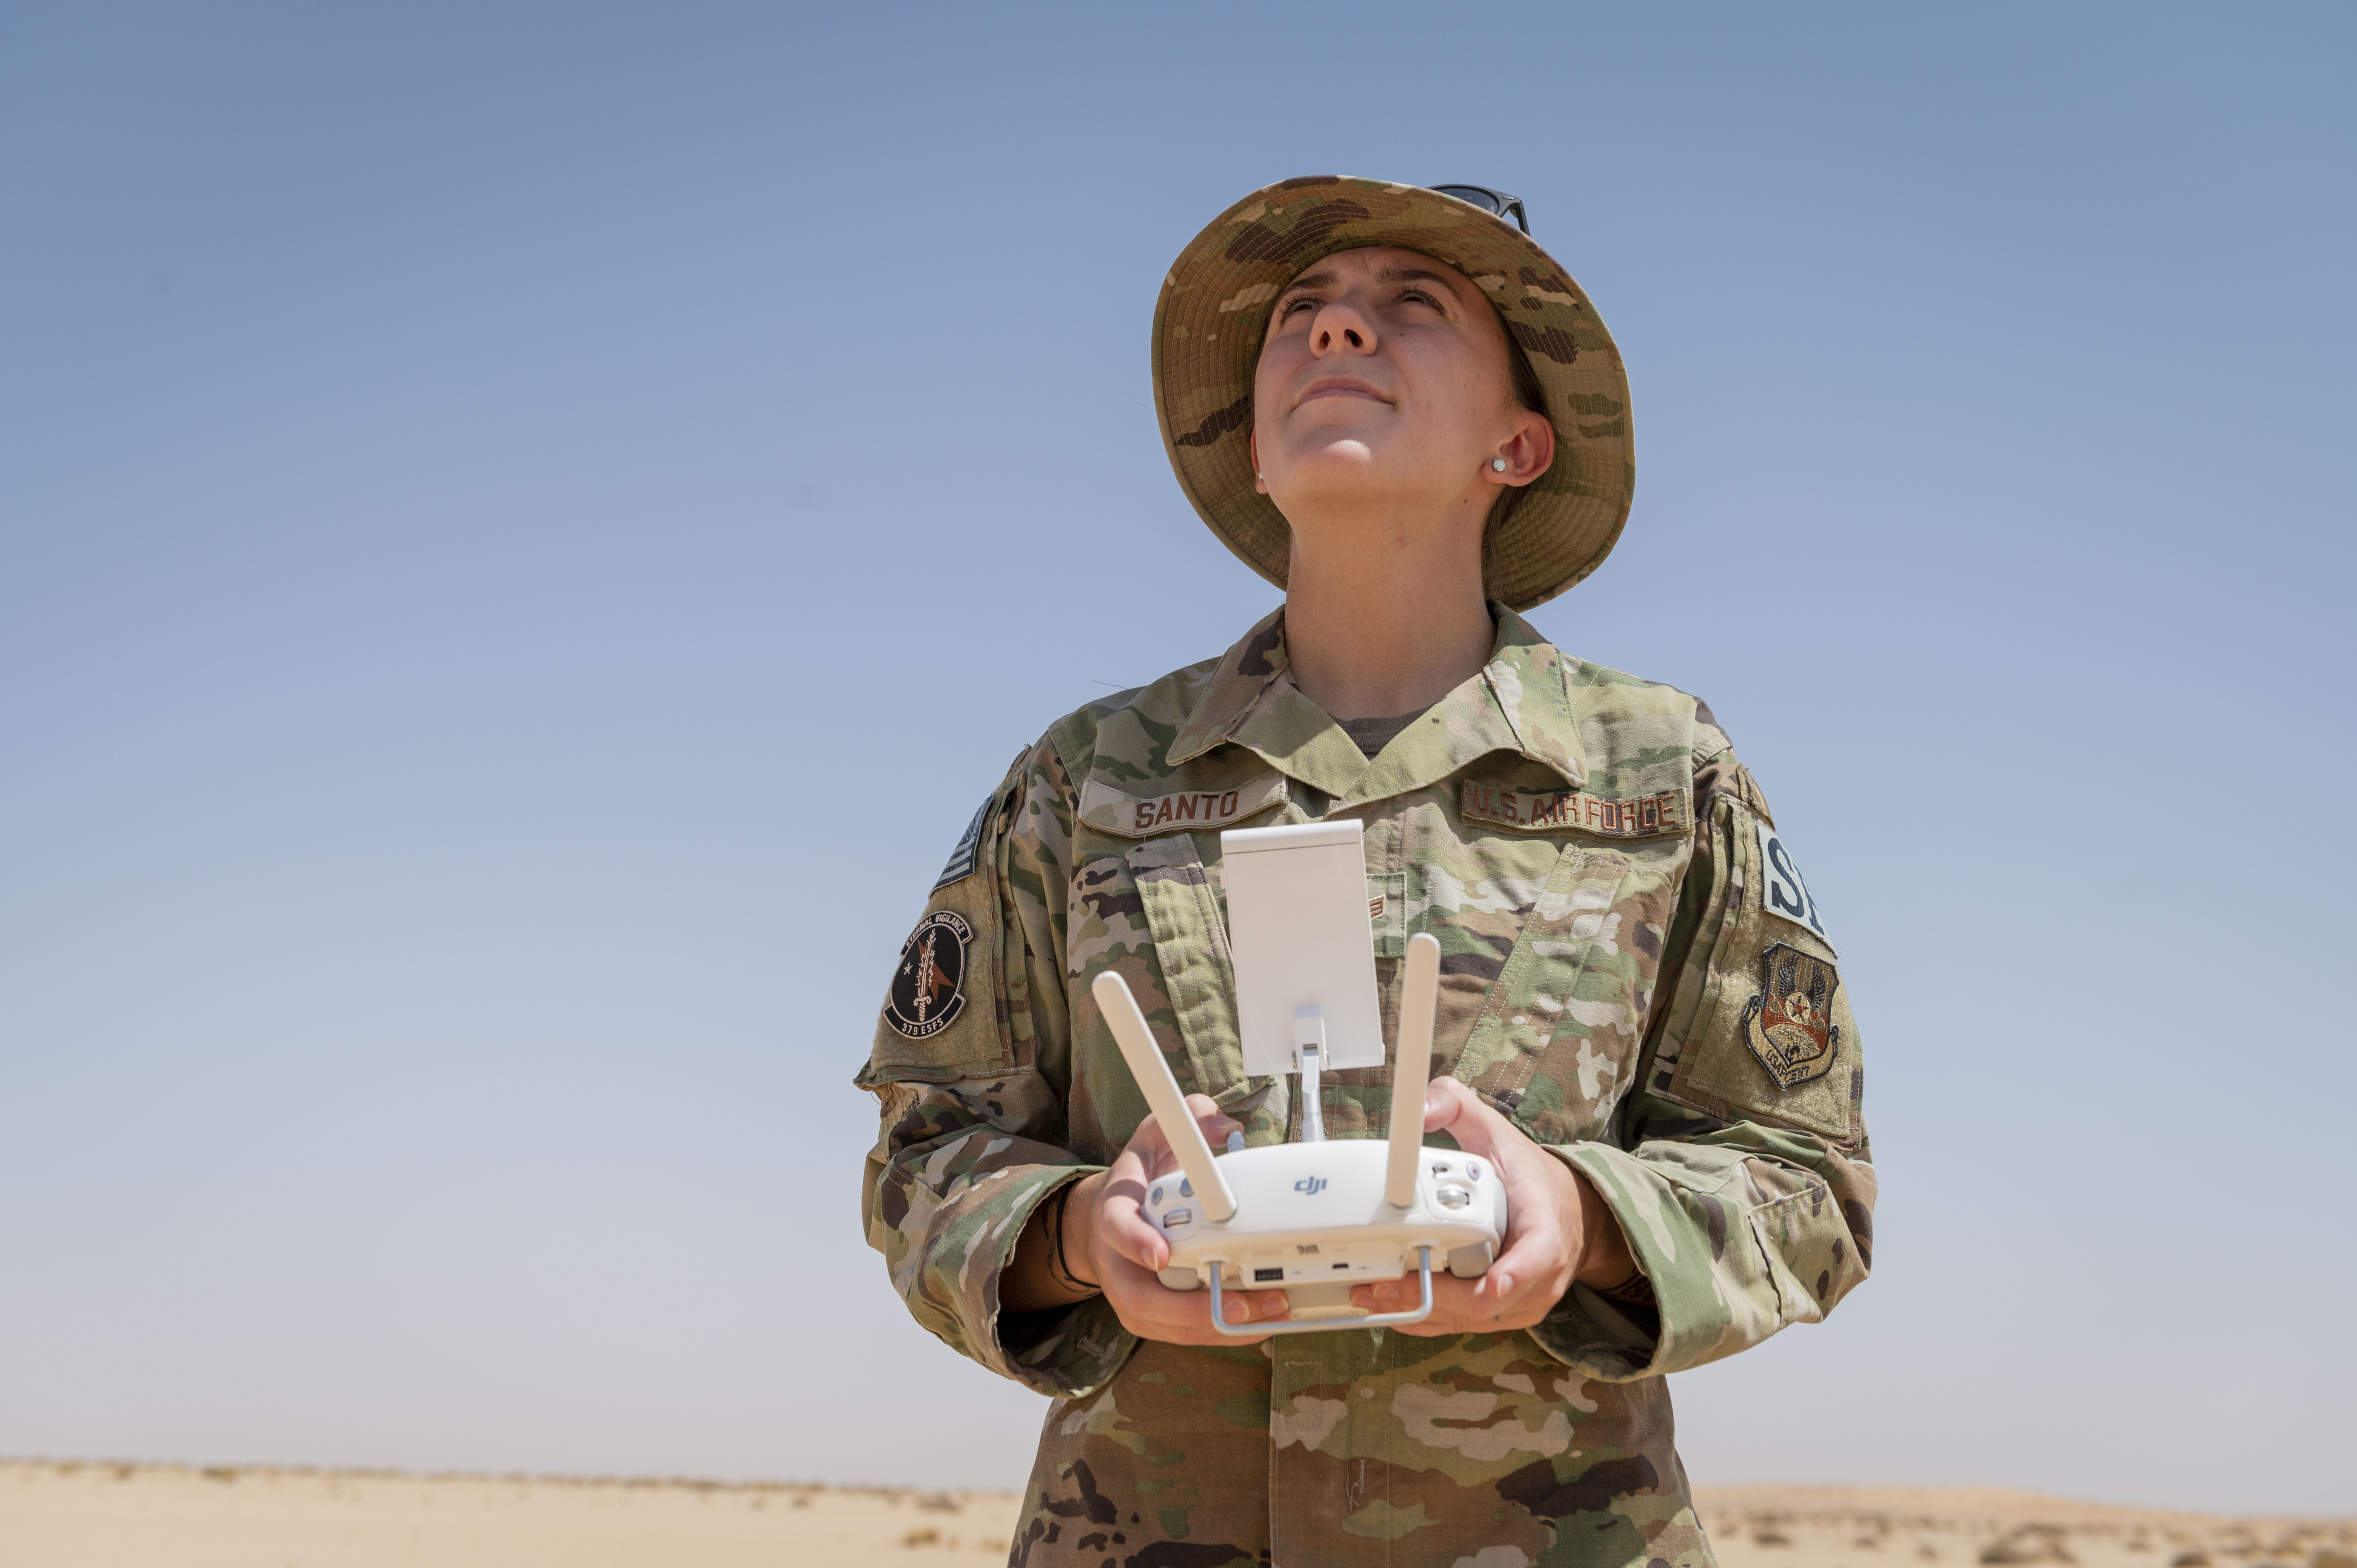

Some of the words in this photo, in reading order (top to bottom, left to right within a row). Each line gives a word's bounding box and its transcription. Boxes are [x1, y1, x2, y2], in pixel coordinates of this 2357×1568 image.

[1135, 791, 1238, 829] SANTO
[1474, 786, 1526, 824] U.S.
[1532, 795, 1580, 825] AIR
[1585, 794, 1677, 831] FORCE
[906, 917, 933, 947] ETERNAL
[935, 913, 965, 935] VIGILANCE
[902, 1023, 918, 1035] 379
[921, 1018, 943, 1035] ESFS
[1765, 1049, 1811, 1082] USAFCENT
